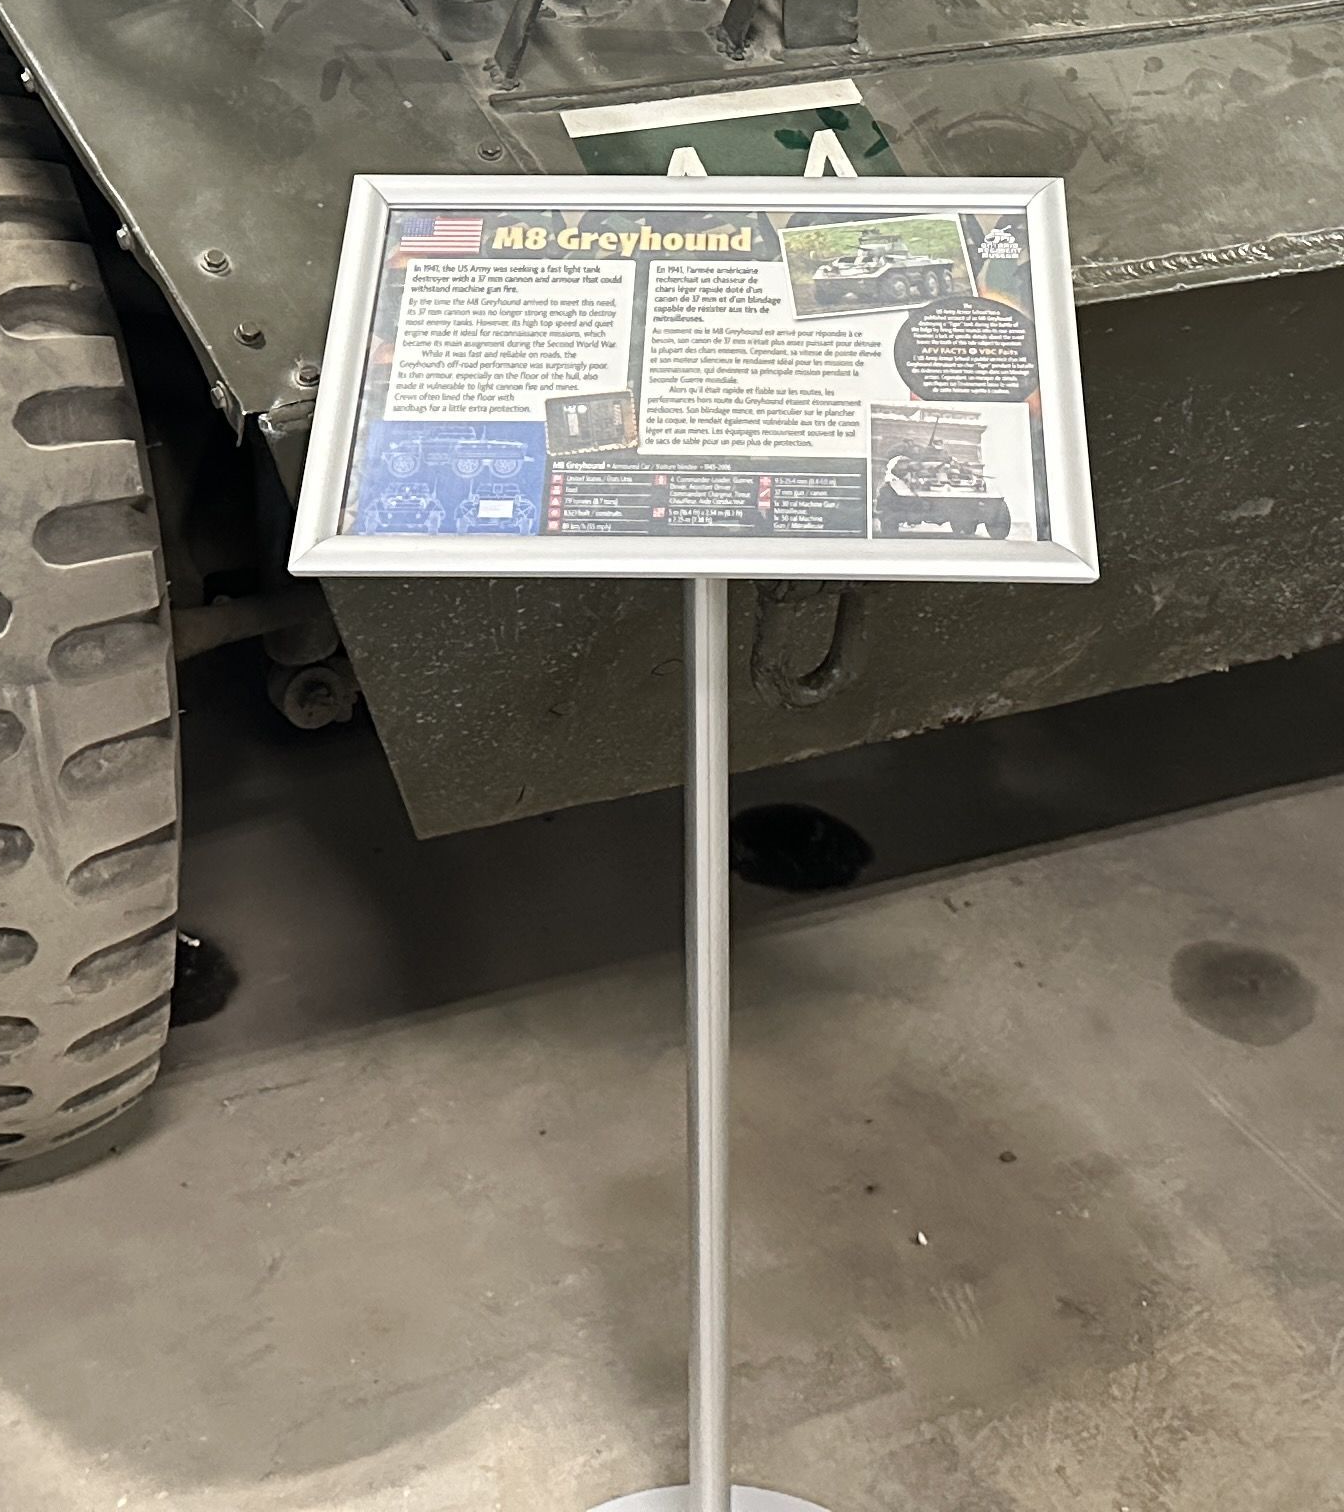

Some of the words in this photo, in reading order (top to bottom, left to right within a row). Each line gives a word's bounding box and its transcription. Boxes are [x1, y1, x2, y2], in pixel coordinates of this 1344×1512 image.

[492, 226, 547, 250] M8
[557, 226, 752, 257] Greyhound
[442, 265, 455, 273] the
[469, 265, 491, 275] Army
[509, 265, 538, 275] seeking
[546, 265, 561, 273] fast
[563, 265, 580, 275] light
[583, 265, 600, 273] tank
[412, 275, 449, 284] destroyer
[451, 275, 469, 283] with
[534, 275, 549, 283] and
[712, 276, 745, 284] chasseur
[411, 285, 450, 293] withstand
[451, 285, 484, 293] machine
[486, 286, 501, 295] gun
[698, 286, 723, 295] rapide
[745, 286, 762, 294] d'un
[728, 296, 745, 304] d'un
[747, 296, 781, 306] blindage
[653, 305, 683, 314] capable
